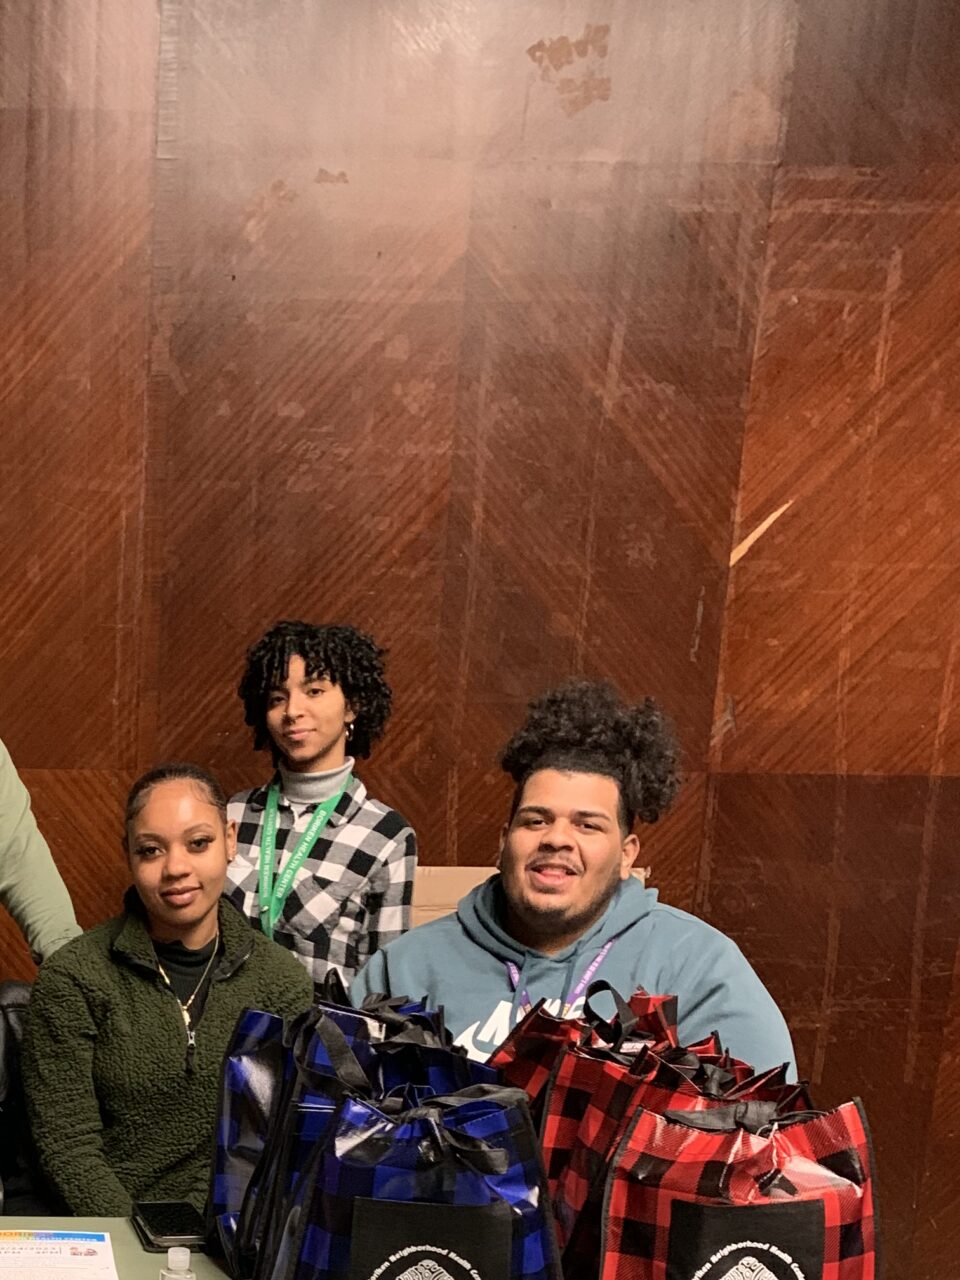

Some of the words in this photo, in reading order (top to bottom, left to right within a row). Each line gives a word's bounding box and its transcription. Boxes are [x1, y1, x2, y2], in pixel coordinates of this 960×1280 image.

[304, 809, 328, 842] BORIKEN
[265, 837, 273, 863] HEALTH
[289, 840, 310, 870] HEALTH
[275, 869, 295, 898] CENTER
